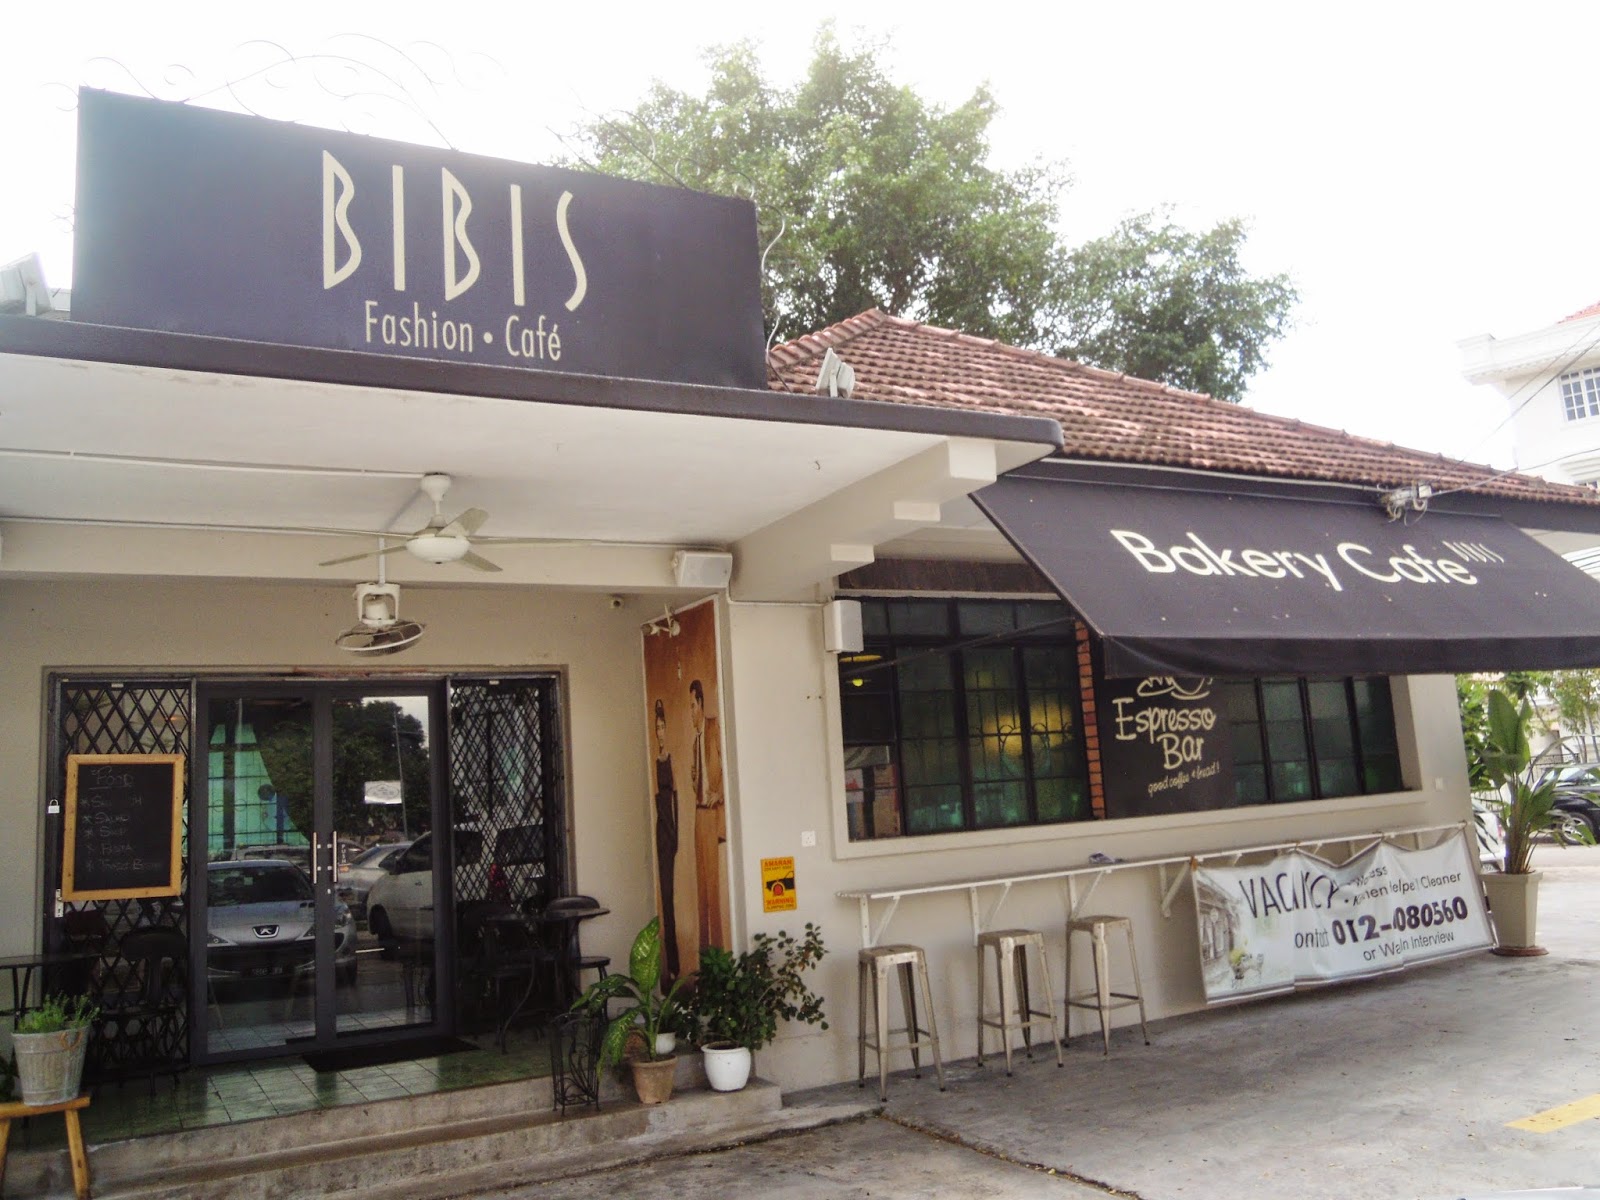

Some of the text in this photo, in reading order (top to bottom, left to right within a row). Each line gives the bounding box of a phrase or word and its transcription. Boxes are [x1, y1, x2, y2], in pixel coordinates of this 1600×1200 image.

[322, 150, 587, 311] BIBIS
[365, 300, 562, 361] Fashion Café
[1110, 529, 1343, 592] Bakery
[1337, 542, 1478, 585] Cafe
[1112, 697, 1217, 744] Espresso
[1156, 733, 1205, 770] Bar
[1420, 872, 1461, 889] Cleaner
[1363, 947, 1377, 962] or
[1411, 931, 1455, 949] Interview
